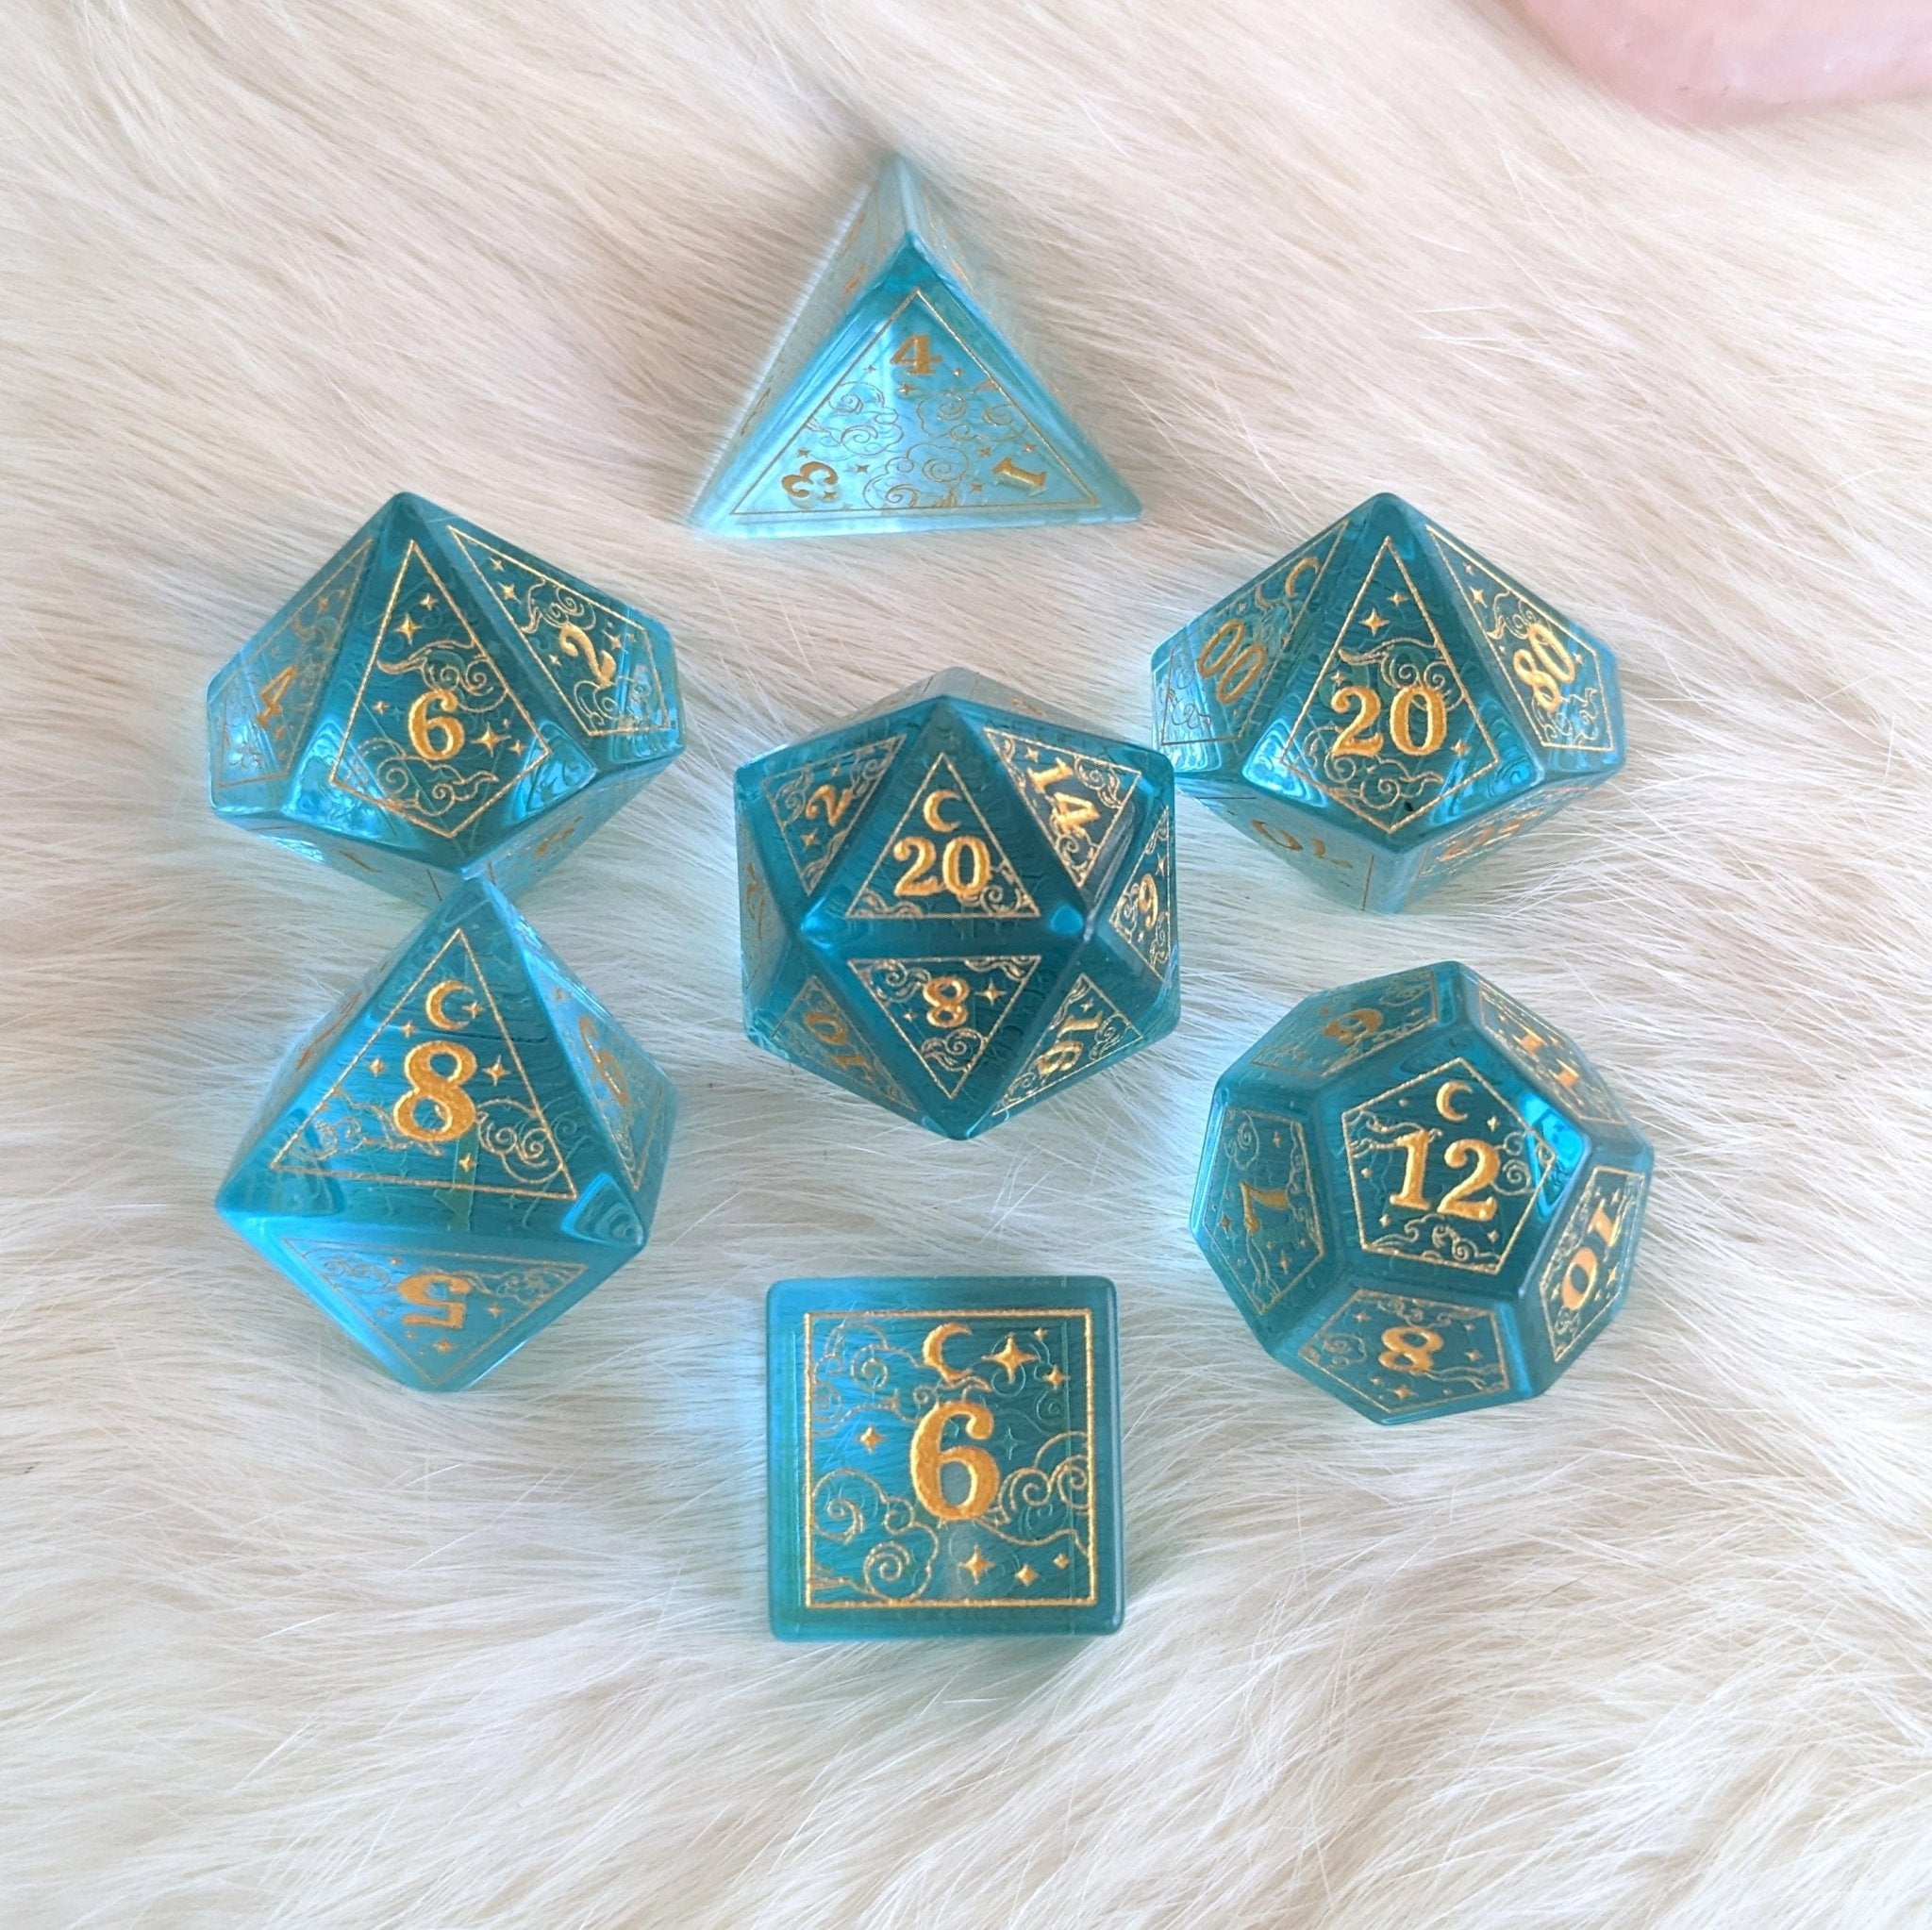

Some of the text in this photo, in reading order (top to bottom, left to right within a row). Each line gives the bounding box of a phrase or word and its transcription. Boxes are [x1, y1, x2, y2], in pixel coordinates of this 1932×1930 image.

[891, 335, 941, 376] 4
[781, 461, 839, 498] 3
[992, 457, 1047, 495] 1
[558, 623, 617, 688] 2
[1197, 618, 1266, 705] 00
[1513, 623, 1575, 714] 80
[256, 664, 298, 728] 4
[408, 689, 465, 760] 6
[1331, 684, 1447, 757] 20
[806, 785, 853, 827] 2
[1026, 757, 1100, 838] 14
[893, 836, 991, 899] 20
[923, 976, 972, 1029] 8
[393, 1040, 477, 1143] 8
[1390, 1129, 1500, 1222] 12
[1561, 1198, 1621, 1311] 10
[396, 1272, 472, 1329] 5
[1378, 1325, 1444, 1373] 8
[910, 1401, 1000, 1522] 6
